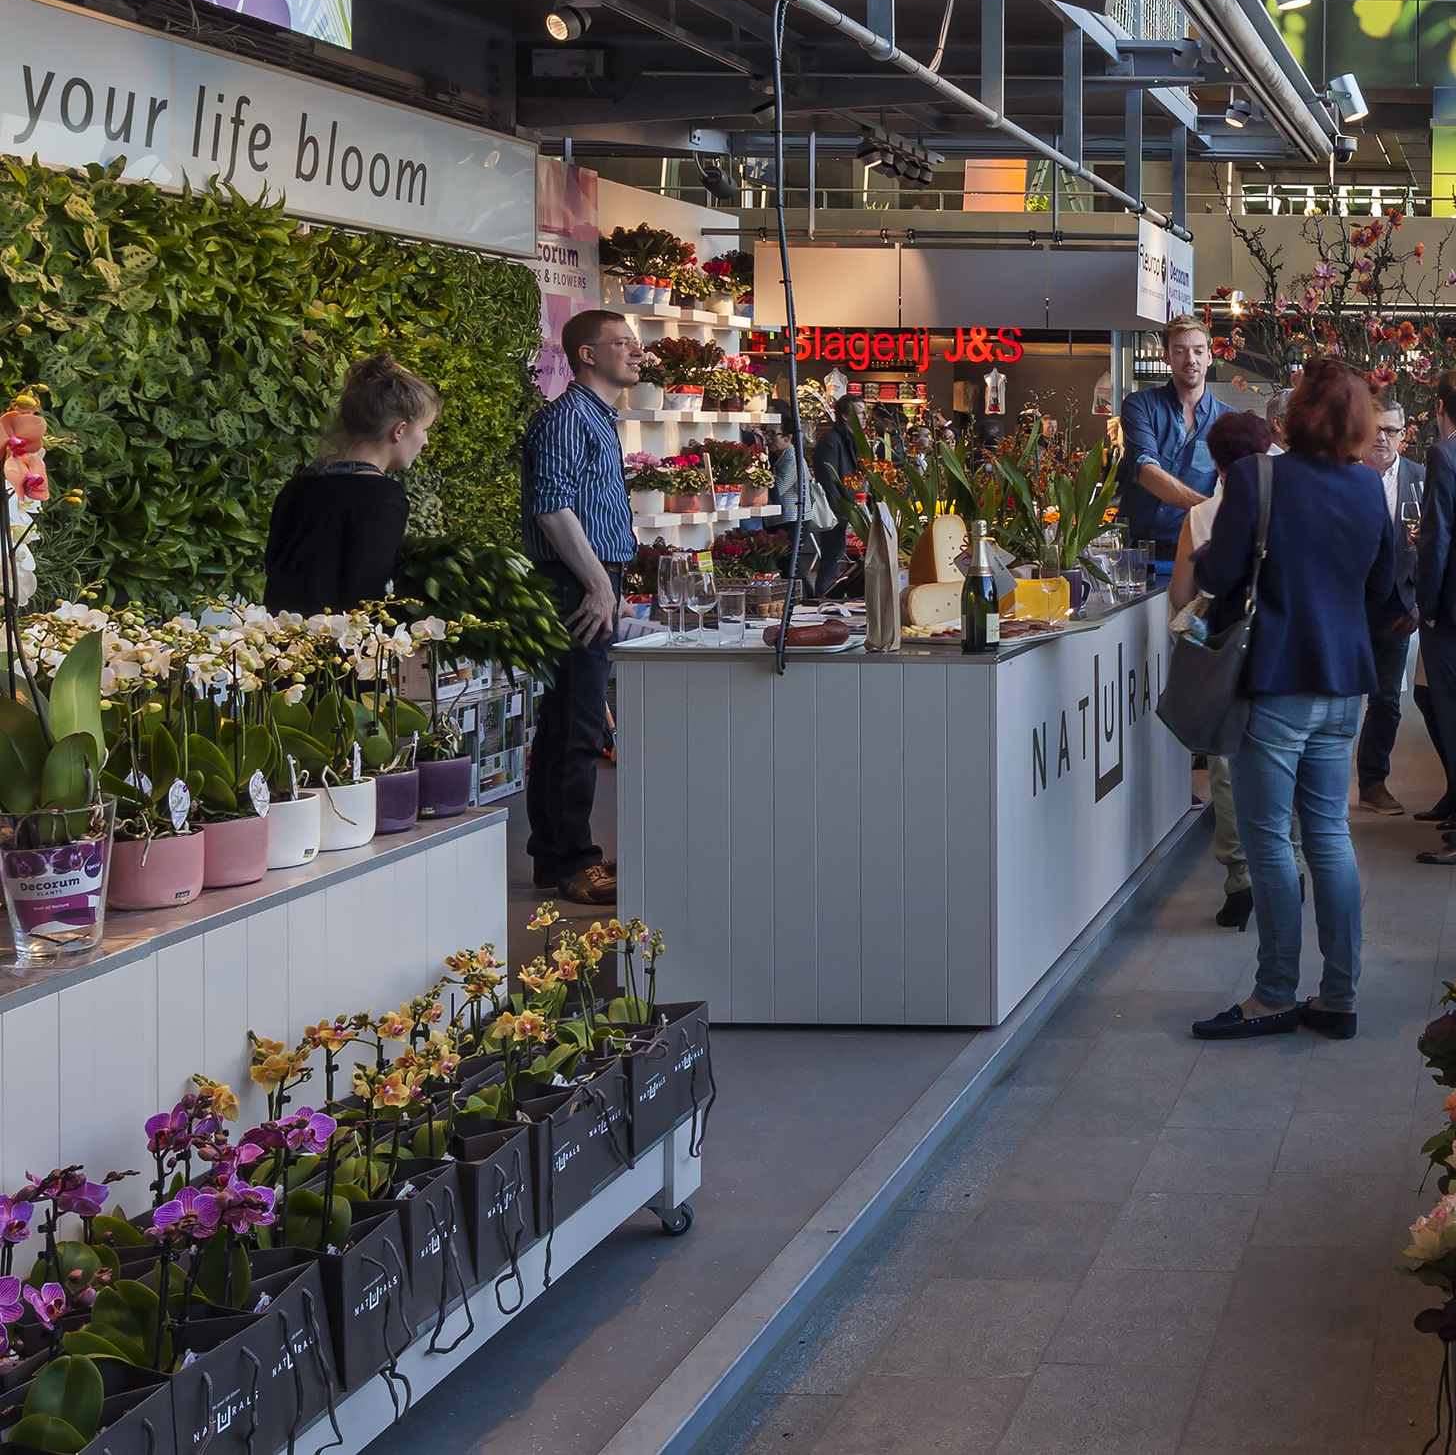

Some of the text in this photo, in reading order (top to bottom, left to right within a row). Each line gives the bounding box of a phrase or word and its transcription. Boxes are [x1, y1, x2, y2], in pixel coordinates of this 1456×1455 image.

[13, 64, 428, 206] your life bloom
[537, 243, 580, 268] corum
[553, 271, 587, 290] FLOWERS
[784, 326, 1023, 372] Slagerij J&S
[1032, 642, 1161, 804] NATURAL
[20, 877, 80, 892] Decorum
[37, 889, 63, 897] PLANTS
[553, 1144, 581, 1173] TURALS
[487, 1183, 525, 1219] NATURAS
[420, 1224, 458, 1259] NATUAS
[354, 1275, 398, 1317] NATURALS
[272, 1336, 315, 1378] NATURAL
[193, 1390, 259, 1444] NAURALS
